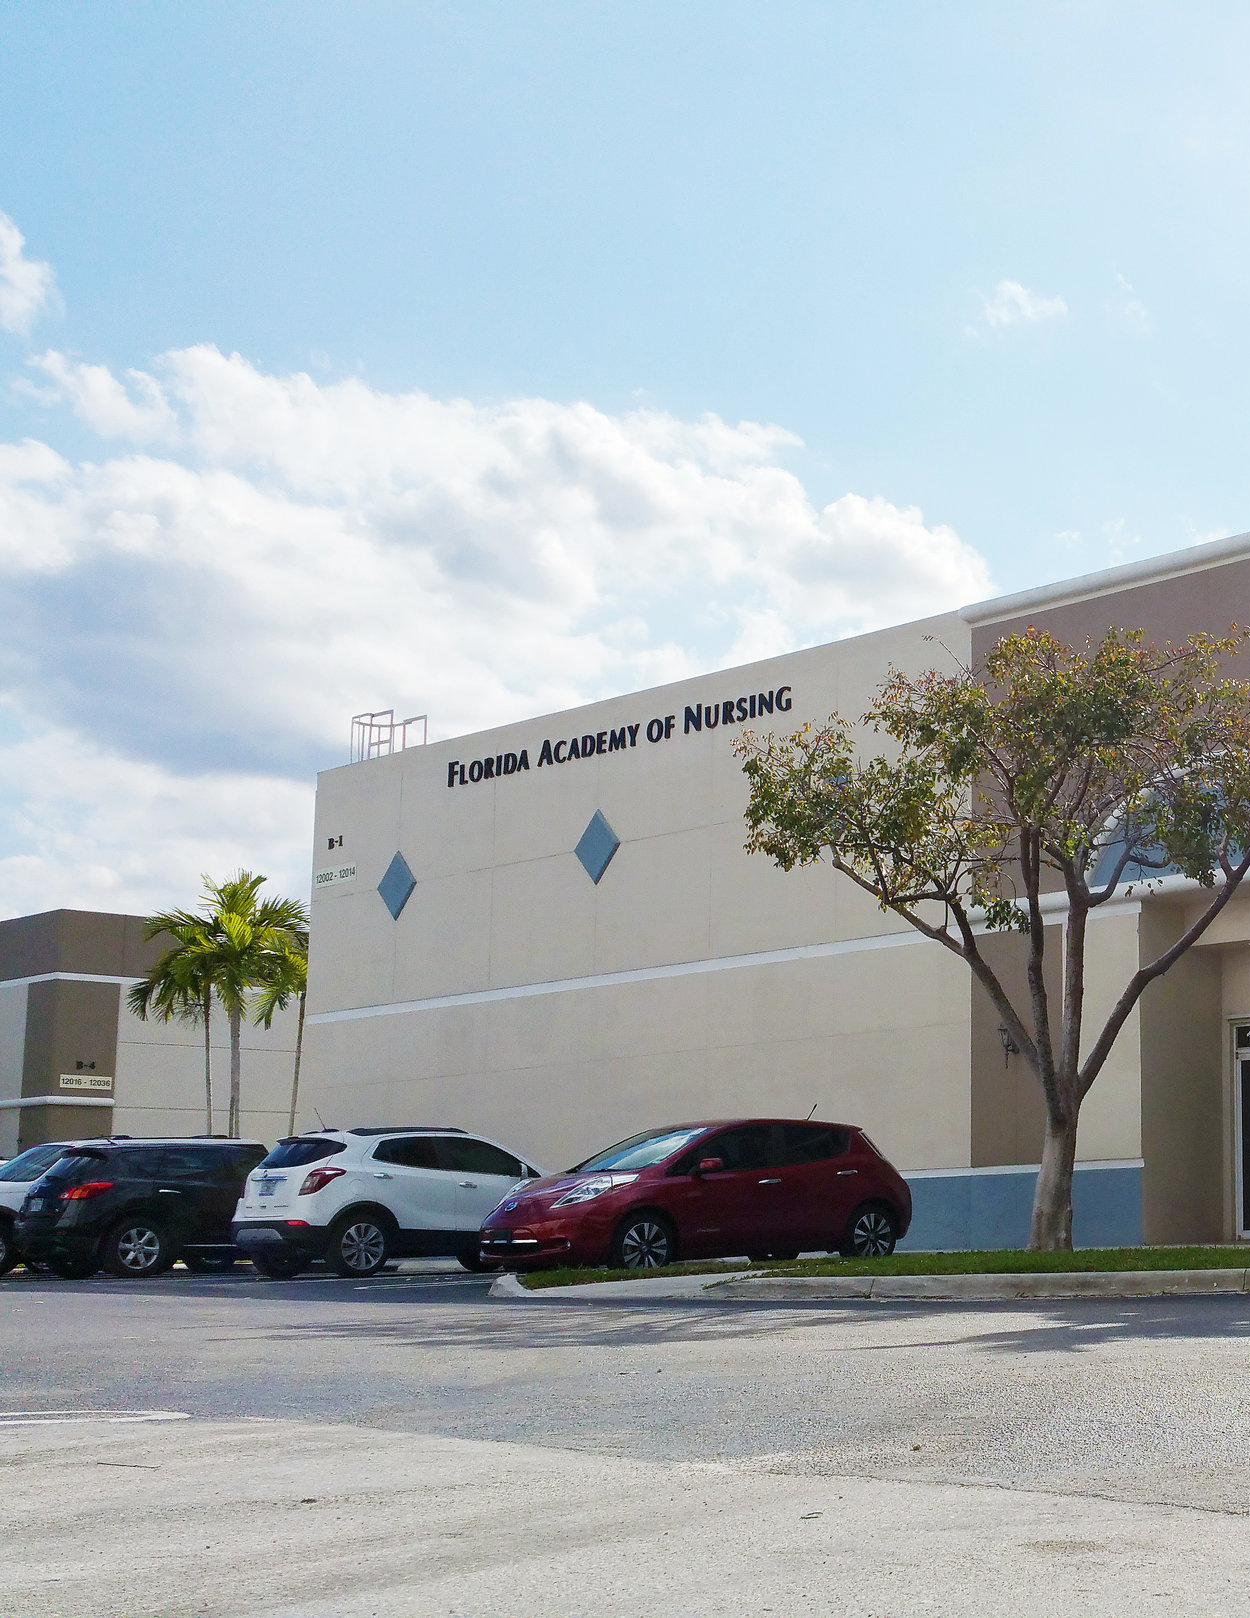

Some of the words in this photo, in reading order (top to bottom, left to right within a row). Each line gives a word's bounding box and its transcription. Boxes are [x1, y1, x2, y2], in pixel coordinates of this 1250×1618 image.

[447, 749, 530, 788] FLORIDA
[536, 723, 641, 768] ACADEMY
[646, 714, 676, 744] OF
[683, 686, 792, 735] NURSING
[316, 871, 334, 884] 12002
[339, 866, 356, 879] 12014
[90, 1079, 111, 1087] 12036
